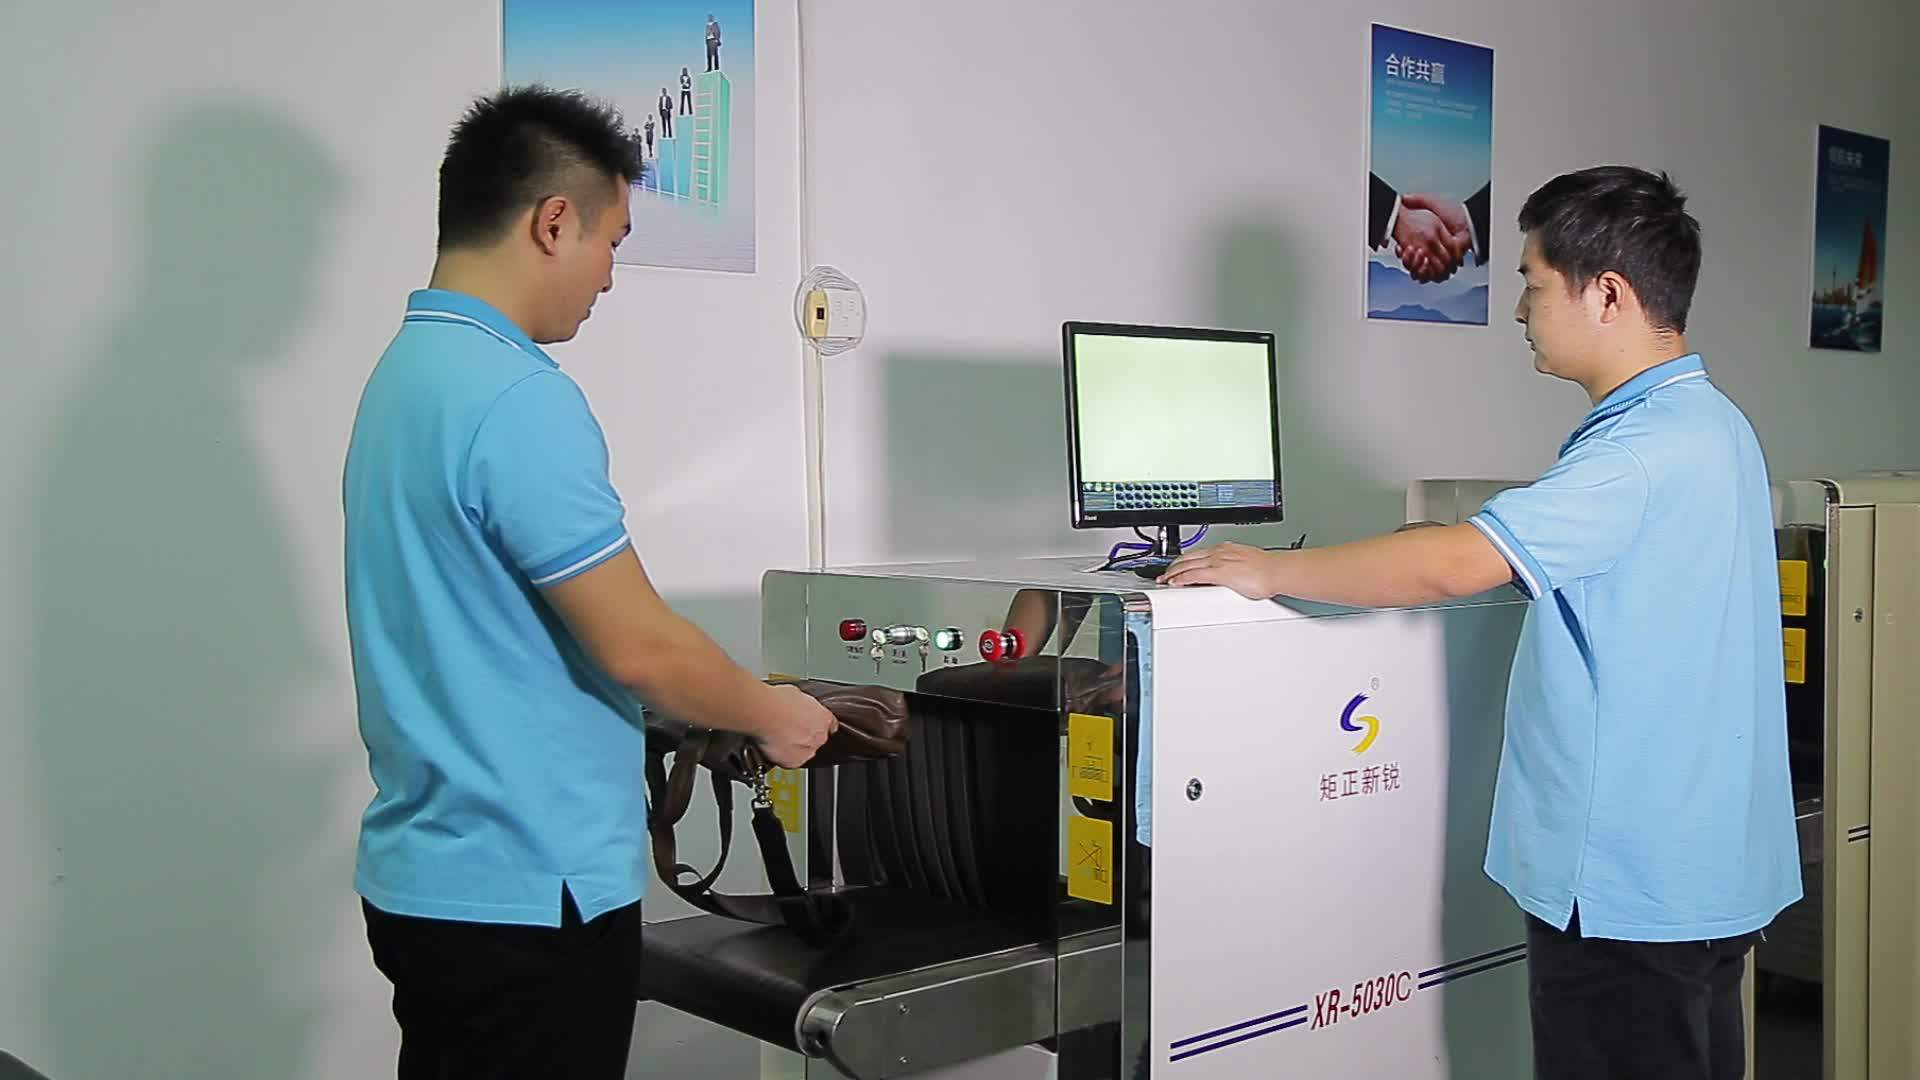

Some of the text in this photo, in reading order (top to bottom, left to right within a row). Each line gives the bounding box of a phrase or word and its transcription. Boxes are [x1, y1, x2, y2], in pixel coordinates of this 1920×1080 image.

[1320, 763, 1400, 801] 矩正新锐
[1311, 972, 1411, 1029] XR-5030C
